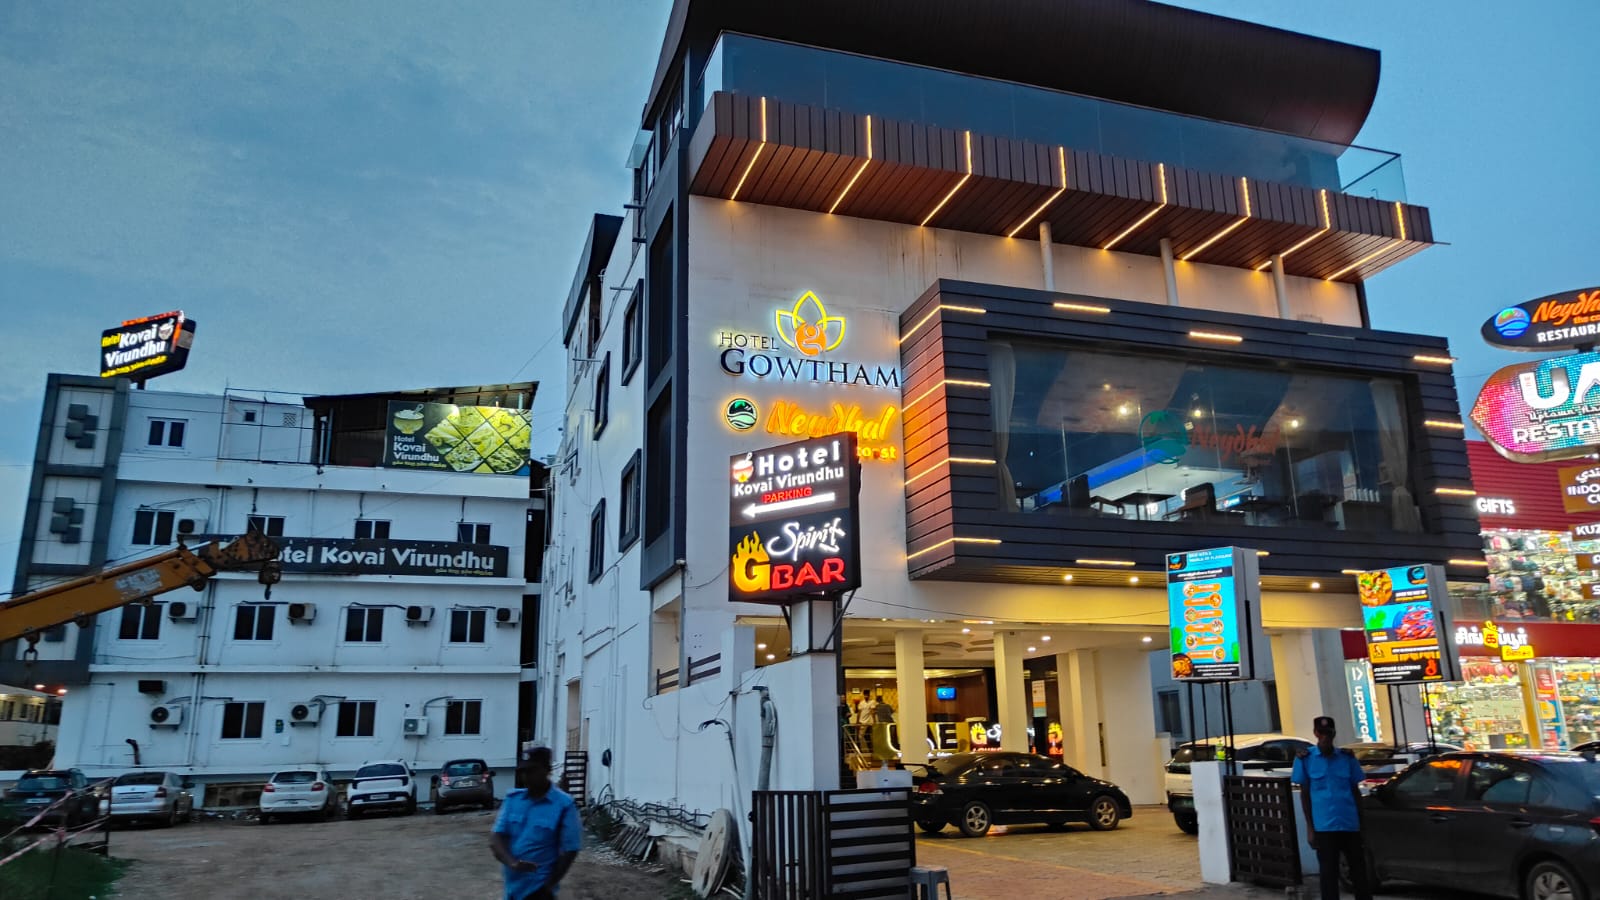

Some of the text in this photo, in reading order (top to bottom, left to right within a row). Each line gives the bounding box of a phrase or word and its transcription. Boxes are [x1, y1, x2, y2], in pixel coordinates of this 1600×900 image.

[119, 324, 158, 348] Kovai
[719, 332, 779, 350] HOTEL
[105, 341, 166, 367] Virundhu
[720, 348, 900, 389] GOWTHAM
[393, 441, 426, 452] Kovai
[393, 451, 440, 462] Virundhu
[758, 440, 841, 476] Hotel
[734, 465, 844, 497] Kovai Virundhu
[763, 487, 812, 503] PARKING
[1476, 497, 1515, 514] GIFTS
[766, 517, 846, 561] Spirit
[320, 546, 386, 565] Kovai
[391, 548, 495, 570] Virundhu
[771, 557, 846, 590] BAR
